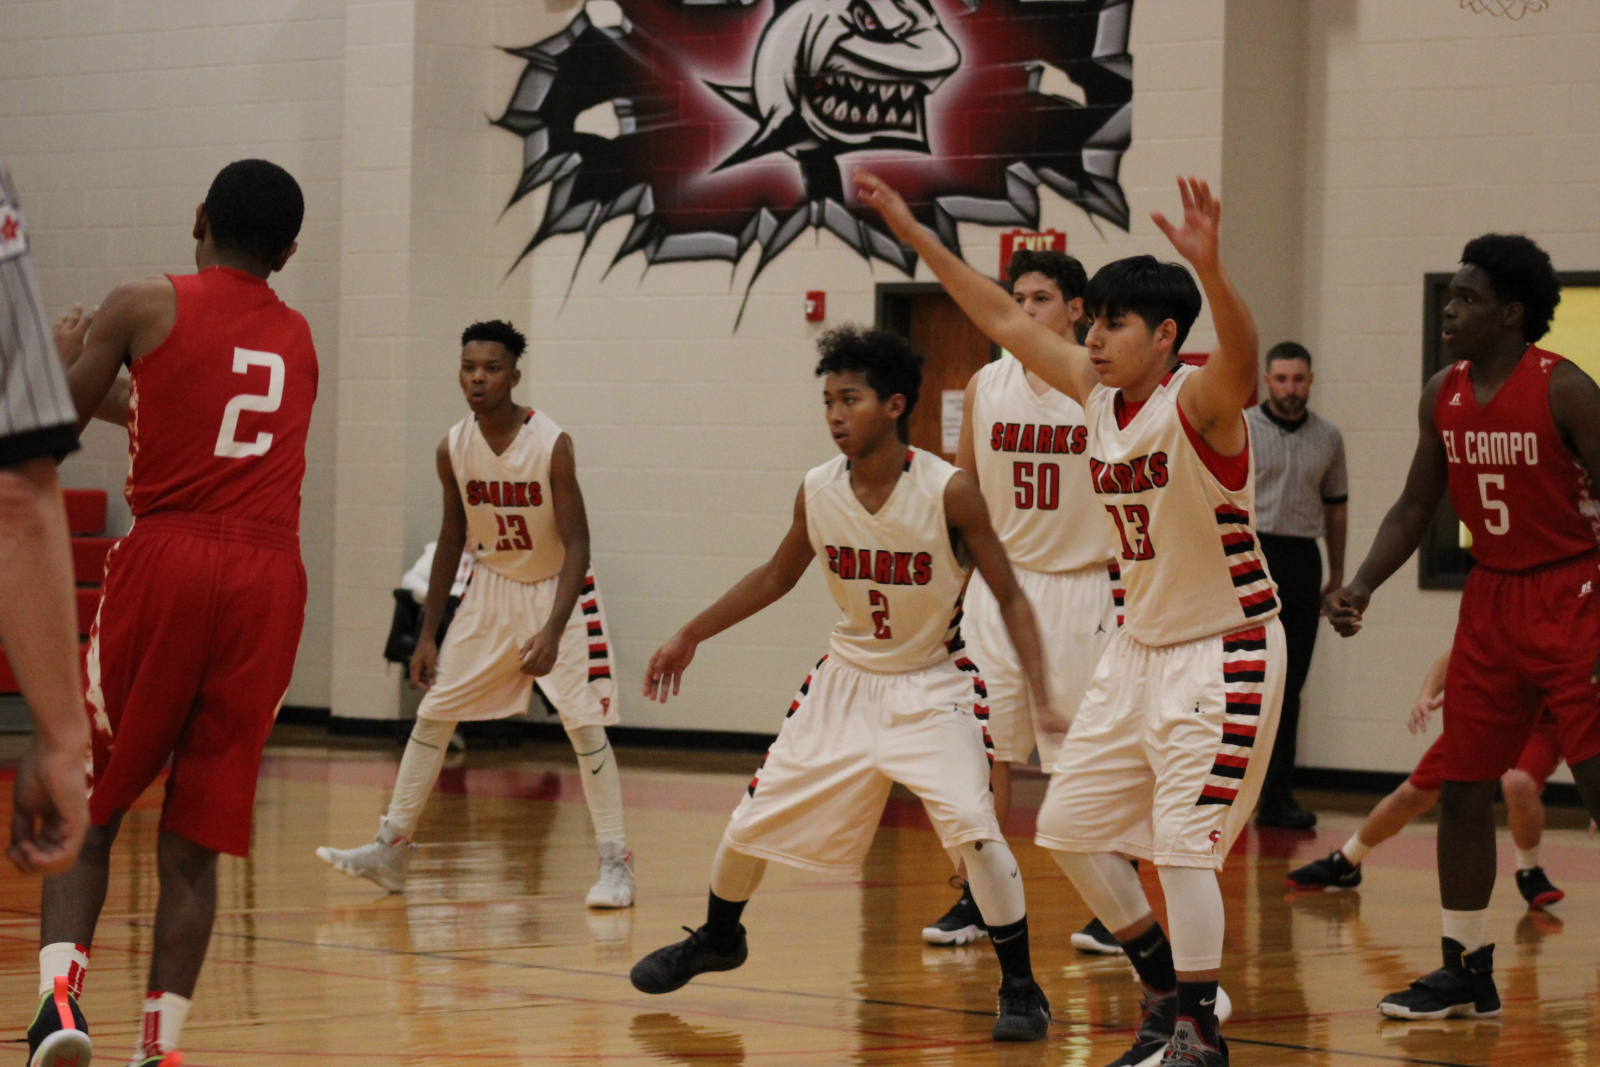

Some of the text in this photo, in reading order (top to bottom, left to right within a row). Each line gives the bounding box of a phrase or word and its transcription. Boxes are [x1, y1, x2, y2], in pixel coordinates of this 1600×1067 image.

[214, 347, 285, 458] 2
[991, 422, 1088, 454] SHARKS
[1443, 430, 1538, 465] EL CAMPO
[1013, 461, 1059, 510] 50
[1089, 451, 1169, 494] HARKS
[1478, 473, 1509, 535] 5
[1104, 504, 1155, 561] 13
[868, 589, 892, 639] 2
